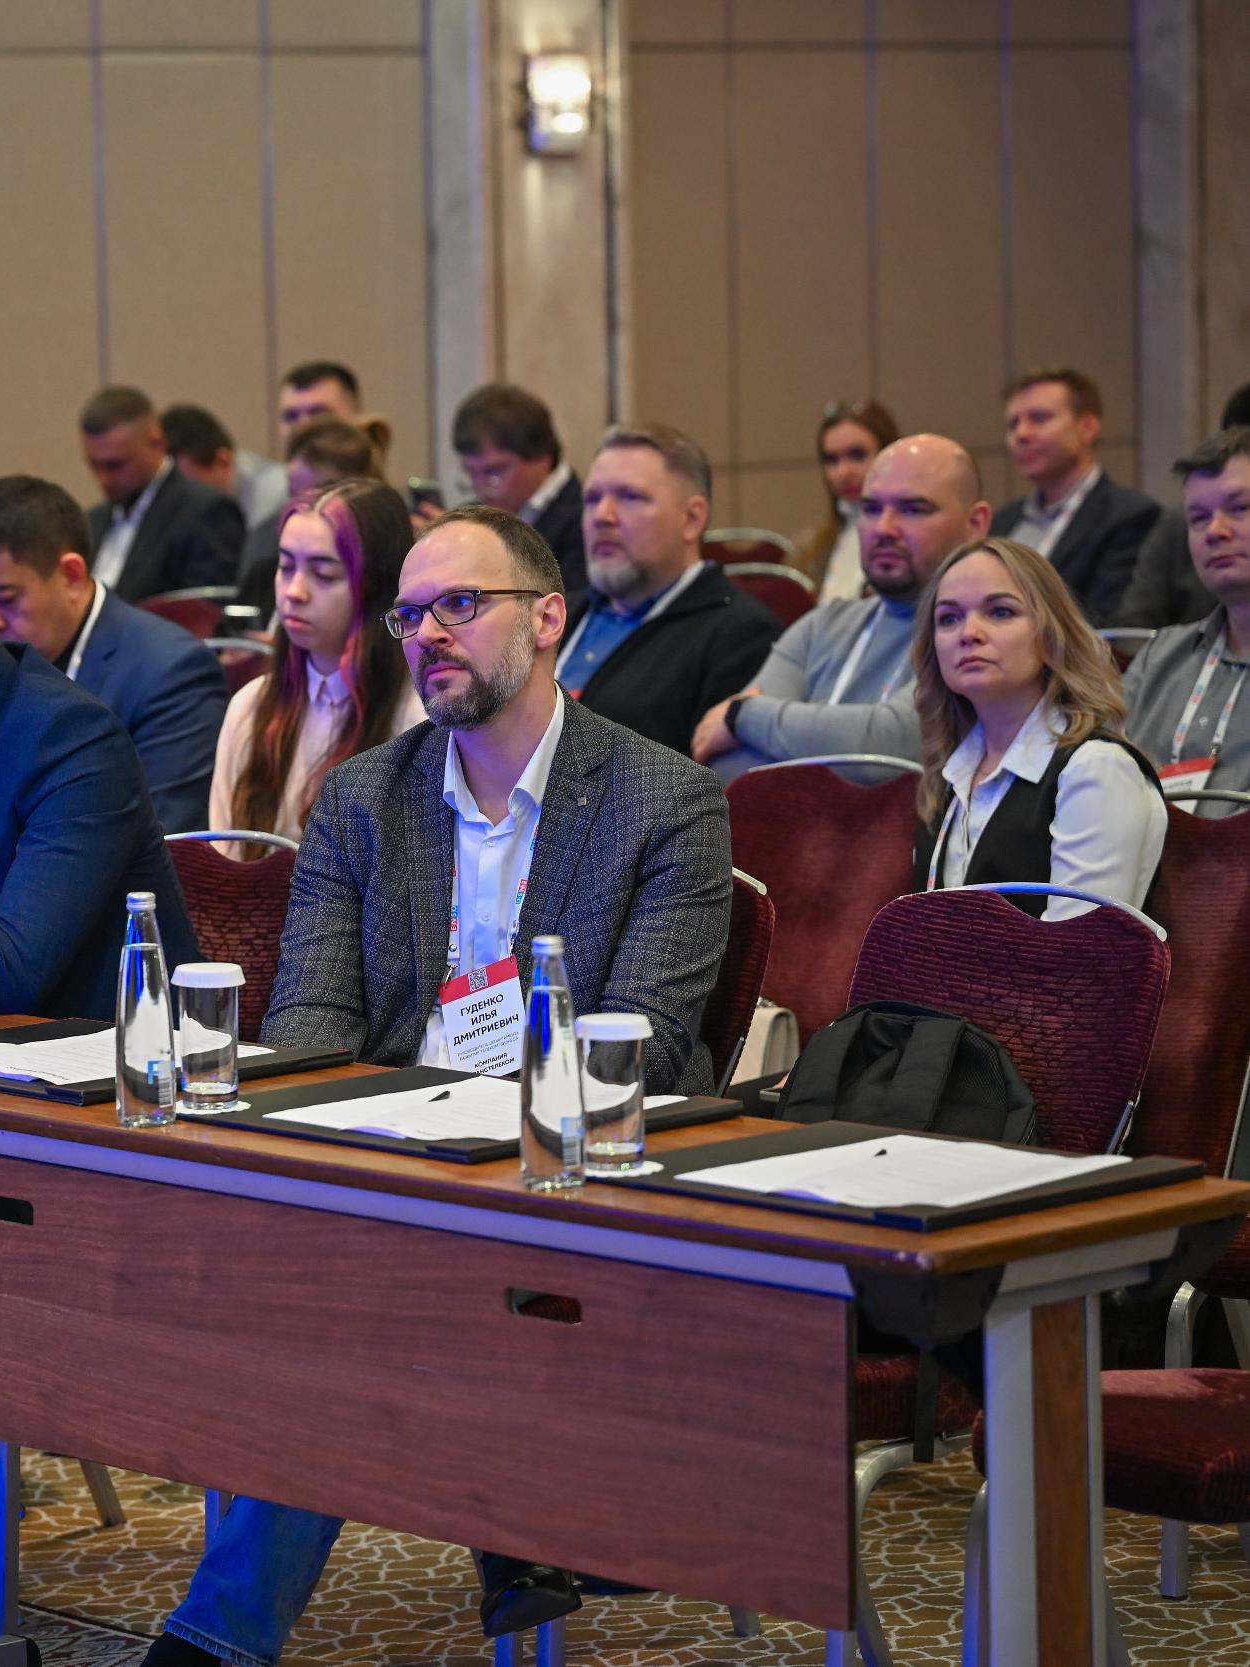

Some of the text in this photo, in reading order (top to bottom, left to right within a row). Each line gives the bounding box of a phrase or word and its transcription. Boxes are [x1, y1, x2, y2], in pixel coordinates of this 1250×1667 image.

[460, 994, 504, 1016] ГУДЕНКО
[471, 1009, 497, 1026] ИЛЬЯ
[453, 1014, 519, 1046] ДМИТРИЕВИЧ
[474, 1052, 508, 1068] КОМПАНИЯ
